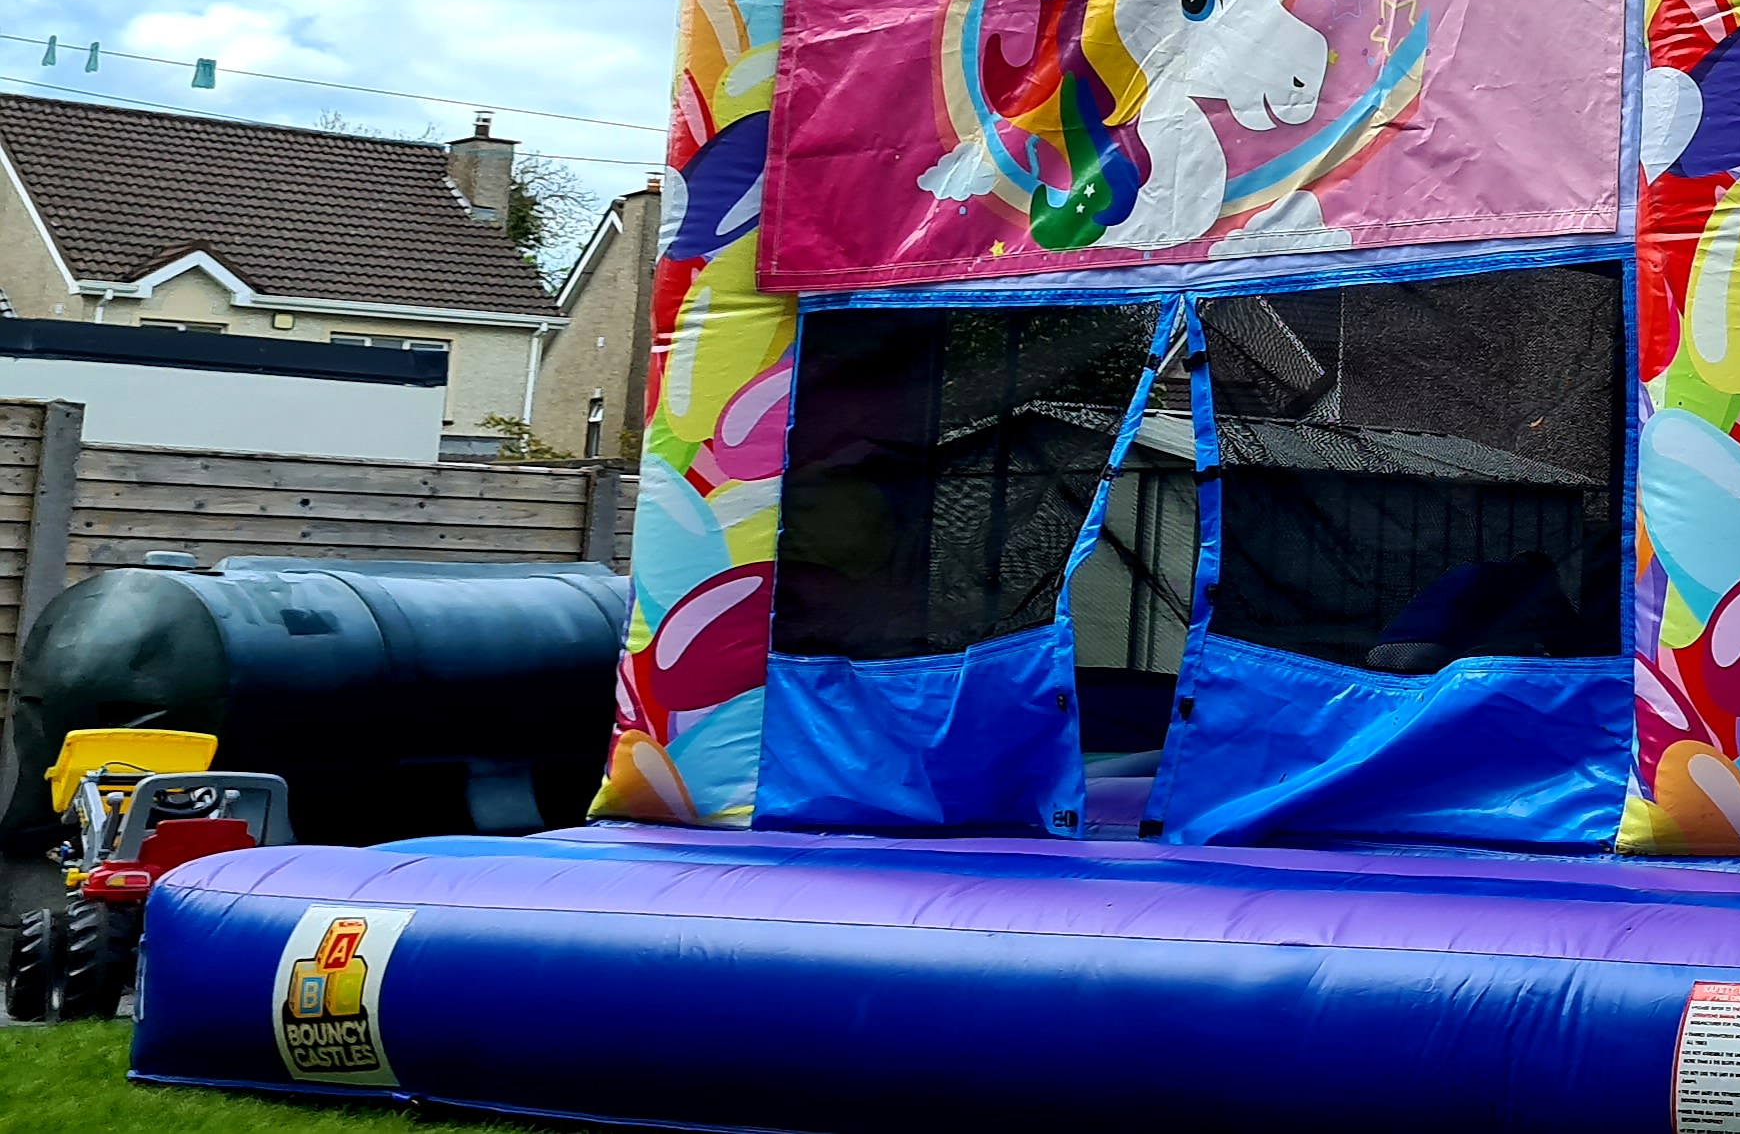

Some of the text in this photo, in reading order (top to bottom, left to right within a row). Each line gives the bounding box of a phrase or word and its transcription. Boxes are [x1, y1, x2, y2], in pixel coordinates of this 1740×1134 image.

[327, 937, 349, 964] A
[303, 981, 319, 1008] B
[287, 1020, 367, 1046] BOUNCY
[295, 1046, 377, 1067] CASTLES
